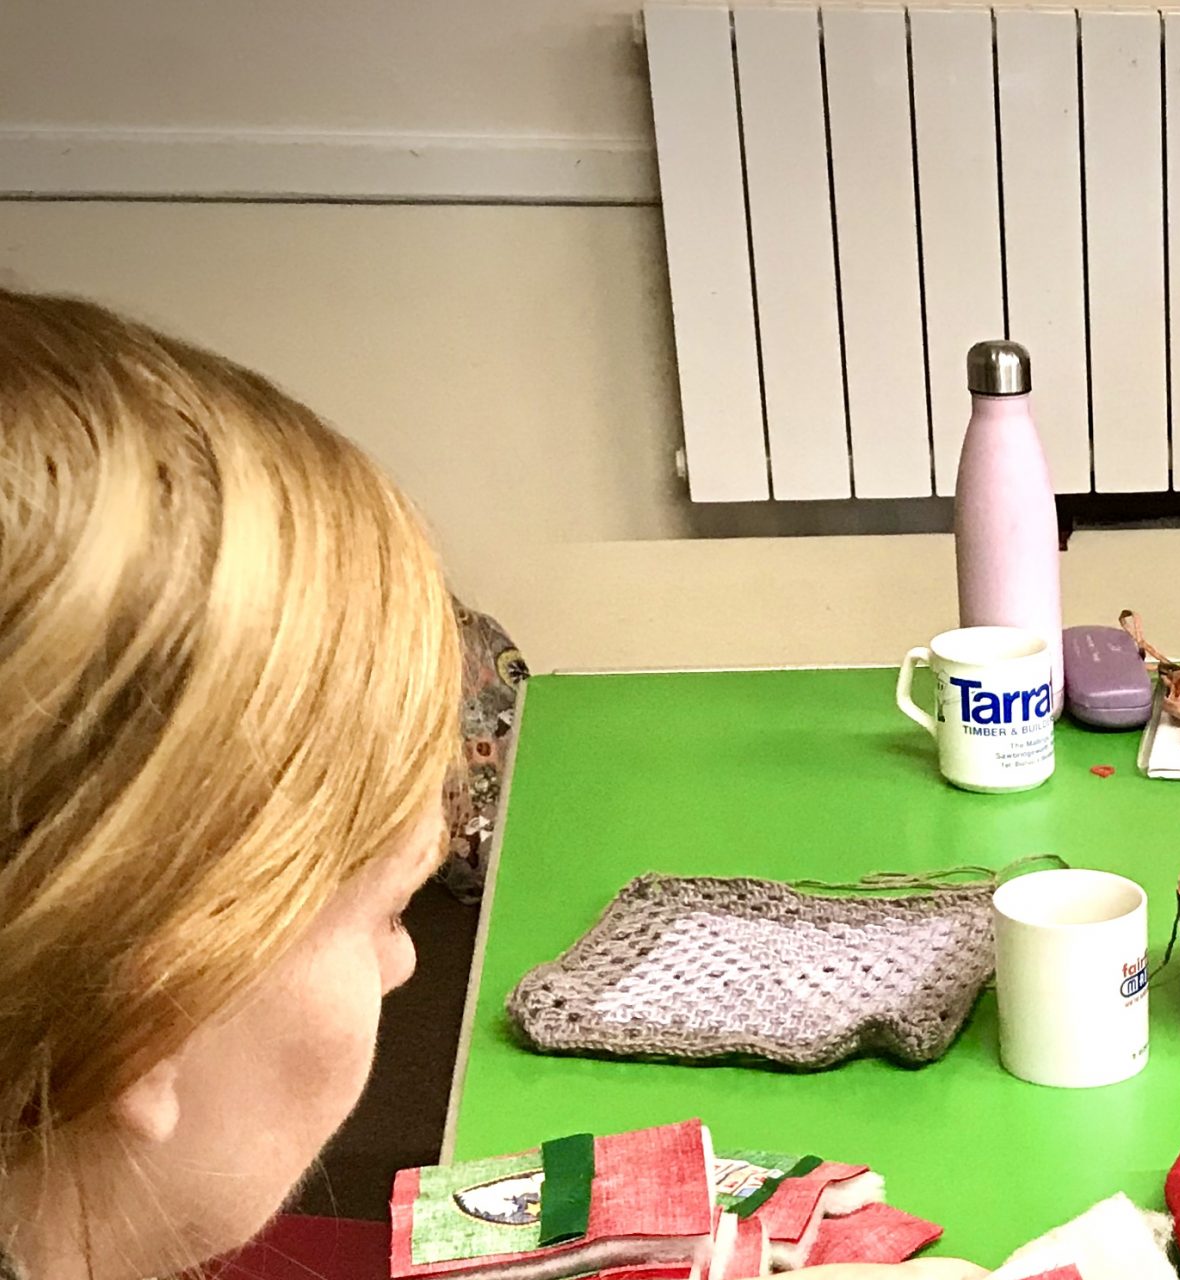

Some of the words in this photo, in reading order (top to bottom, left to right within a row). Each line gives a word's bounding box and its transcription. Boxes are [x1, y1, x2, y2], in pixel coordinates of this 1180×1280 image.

[949, 676, 1051, 724] Tarra
[963, 725, 1006, 737] TIMBER
[1011, 728, 1018, 736] &
